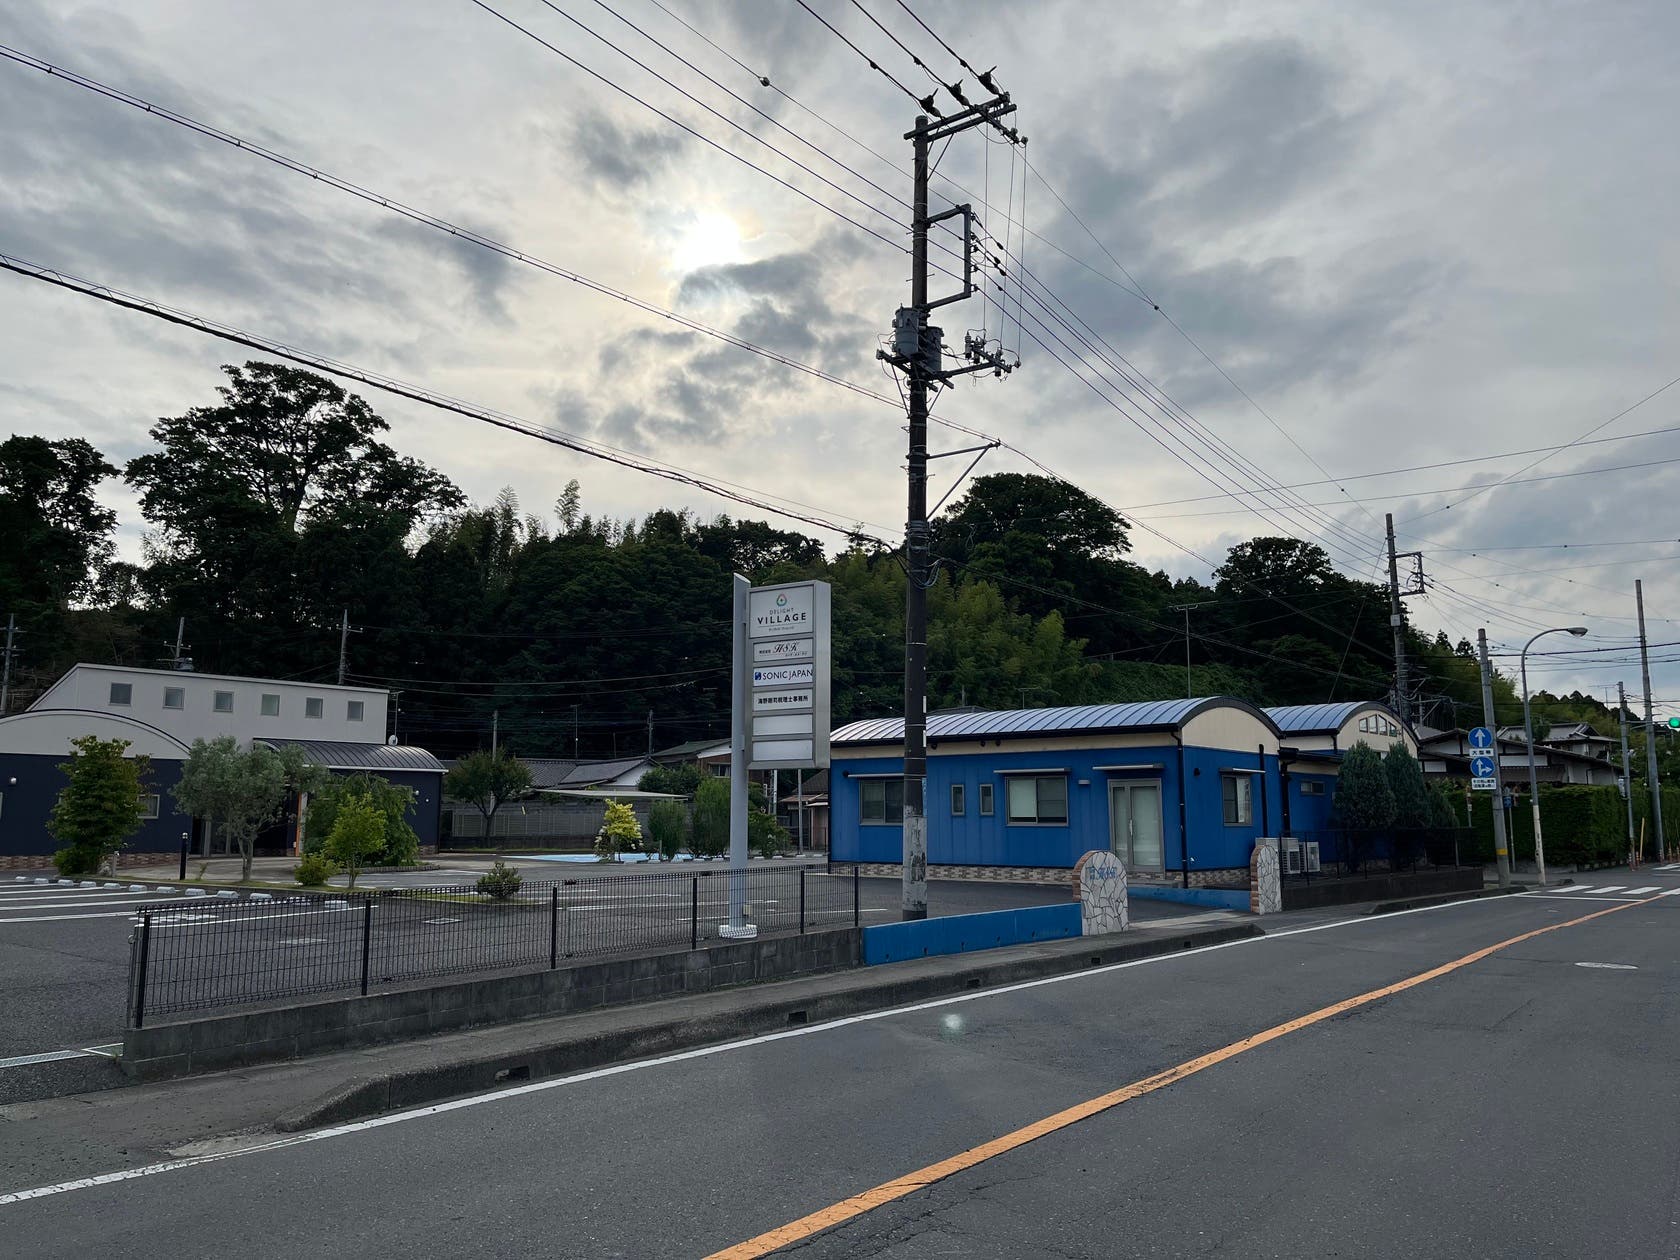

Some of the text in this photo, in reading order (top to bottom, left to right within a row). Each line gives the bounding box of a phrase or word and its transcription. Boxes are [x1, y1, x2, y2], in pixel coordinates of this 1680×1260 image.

[757, 612, 806, 624] VILLAGE
[762, 669, 813, 681] SONIC JAPAN
